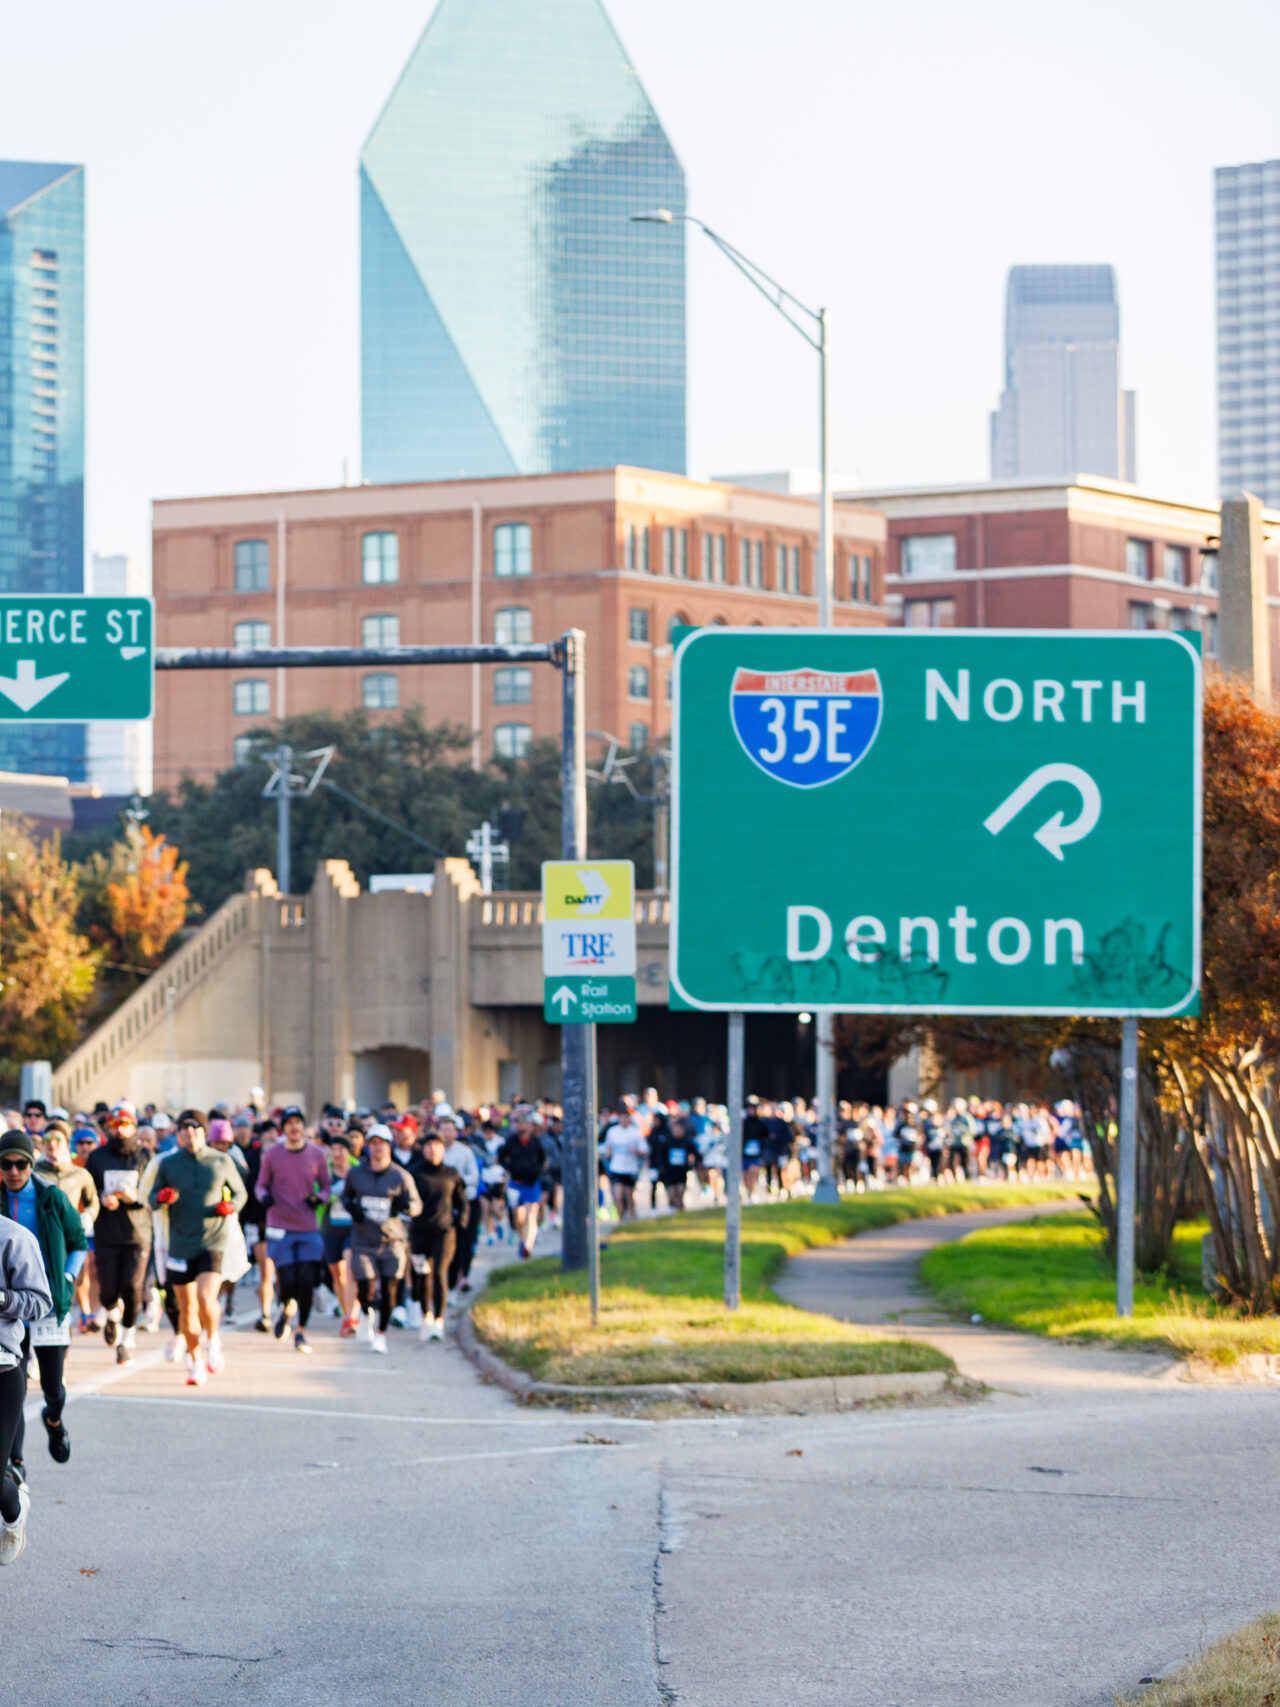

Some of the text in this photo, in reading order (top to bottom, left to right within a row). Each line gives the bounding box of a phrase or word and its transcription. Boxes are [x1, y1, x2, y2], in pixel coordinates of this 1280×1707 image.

[106, 609, 142, 642] ST
[765, 676, 846, 693] INTERSTATE
[926, 669, 1146, 723] NORTH
[759, 698, 852, 763] 35E
[564, 895, 601, 904] DART
[561, 932, 614, 957] TRE
[786, 905, 1084, 965] Denton
[581, 983, 608, 997] Rail
[581, 1002, 632, 1015] Station
